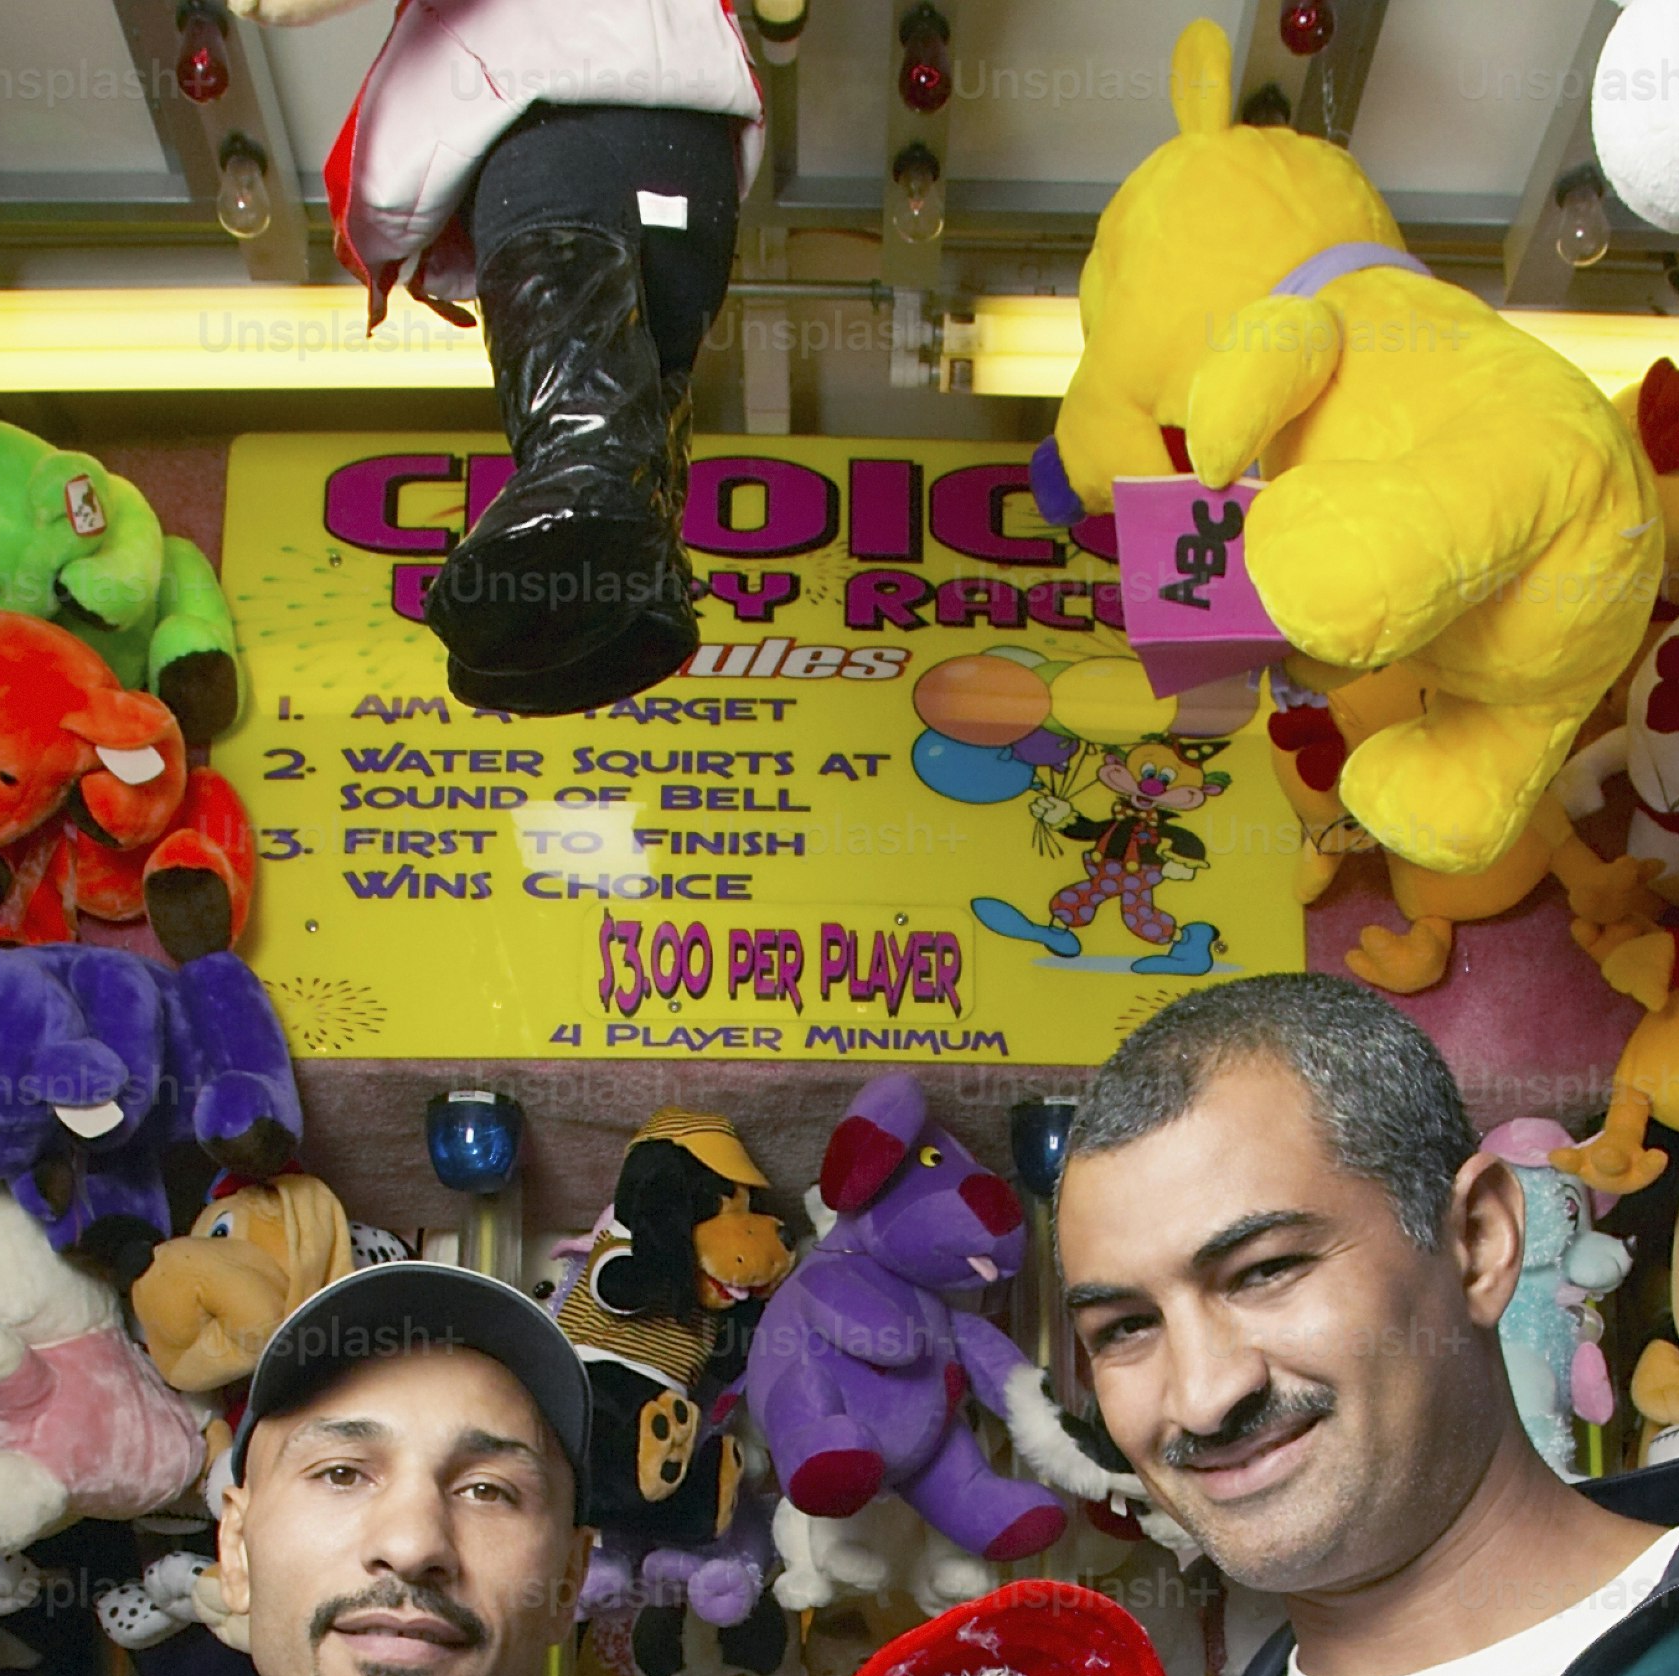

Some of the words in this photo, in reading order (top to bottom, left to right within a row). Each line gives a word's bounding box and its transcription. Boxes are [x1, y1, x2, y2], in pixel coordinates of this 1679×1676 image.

[324, 453, 1117, 565] COIC
[1159, 500, 1244, 611] ABC
[675, 637, 914, 680] ules
[350, 694, 451, 725] AIM
[263, 747, 316, 780] 2.
[341, 741, 545, 778] WATER
[572, 746, 795, 779] SQUIRTS
[817, 752, 891, 782] AT
[340, 783, 528, 812] SOUND
[553, 786, 632, 811] OF
[660, 784, 811, 813] BELL
[261, 827, 314, 860] 3.
[344, 827, 498, 859] FIRST
[522, 830, 604, 854] TO
[631, 828, 806, 857] FINISH
[342, 863, 492, 900] WINS
[522, 871, 753, 901] CHOICE
[599, 907, 713, 1018] $3.00
[728, 928, 805, 1017] PER
[820, 922, 962, 1019] PLAYER
[549, 1023, 582, 1048] 4
[606, 1023, 782, 1052] PLAYER
[804, 1024, 1010, 1057] MINIMUM
